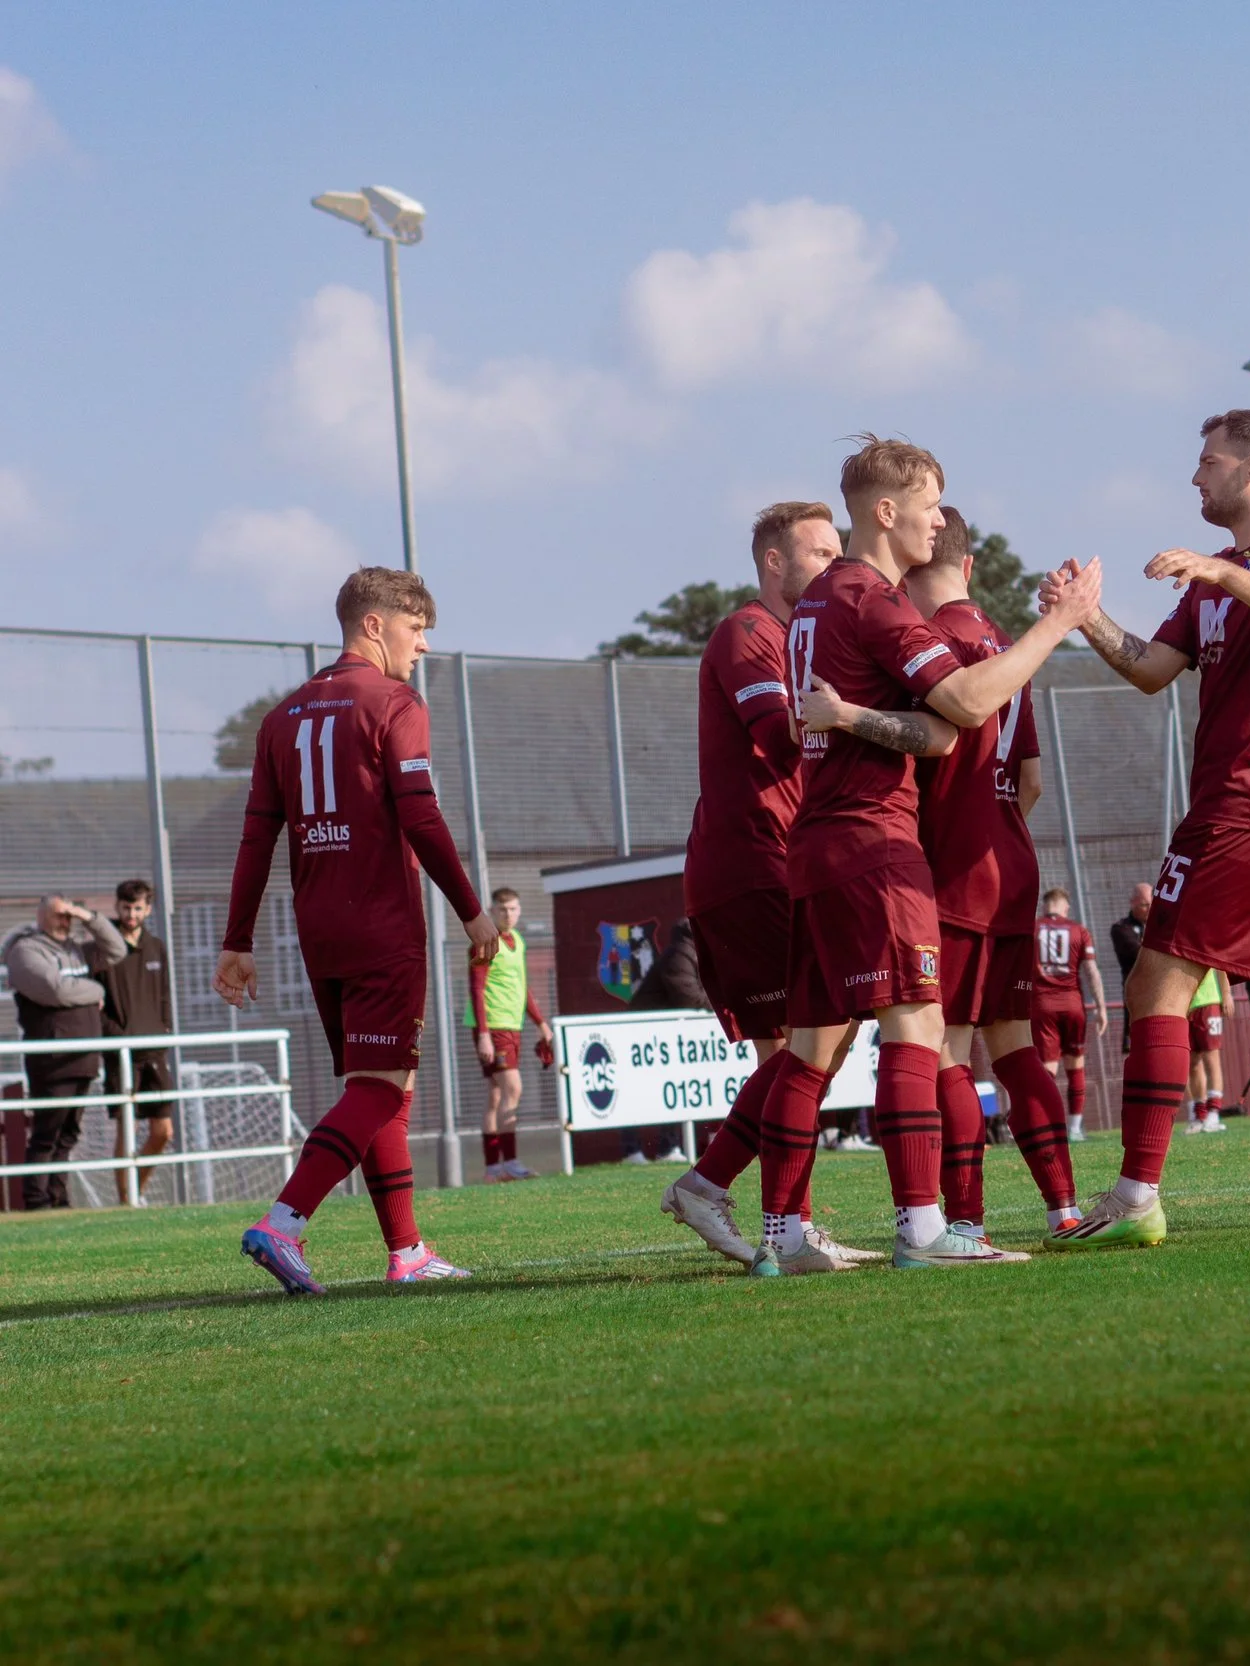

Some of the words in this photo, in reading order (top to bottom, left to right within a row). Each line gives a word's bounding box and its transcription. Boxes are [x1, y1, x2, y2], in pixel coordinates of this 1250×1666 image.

[295, 715, 337, 816] 11
[1038, 928, 1070, 964] 10
[359, 1033, 398, 1045] FORRIT
[631, 1035, 670, 1068] ac's
[677, 1030, 727, 1064] taxis
[736, 1040, 749, 1061] &
[663, 1078, 713, 1110] 0131
